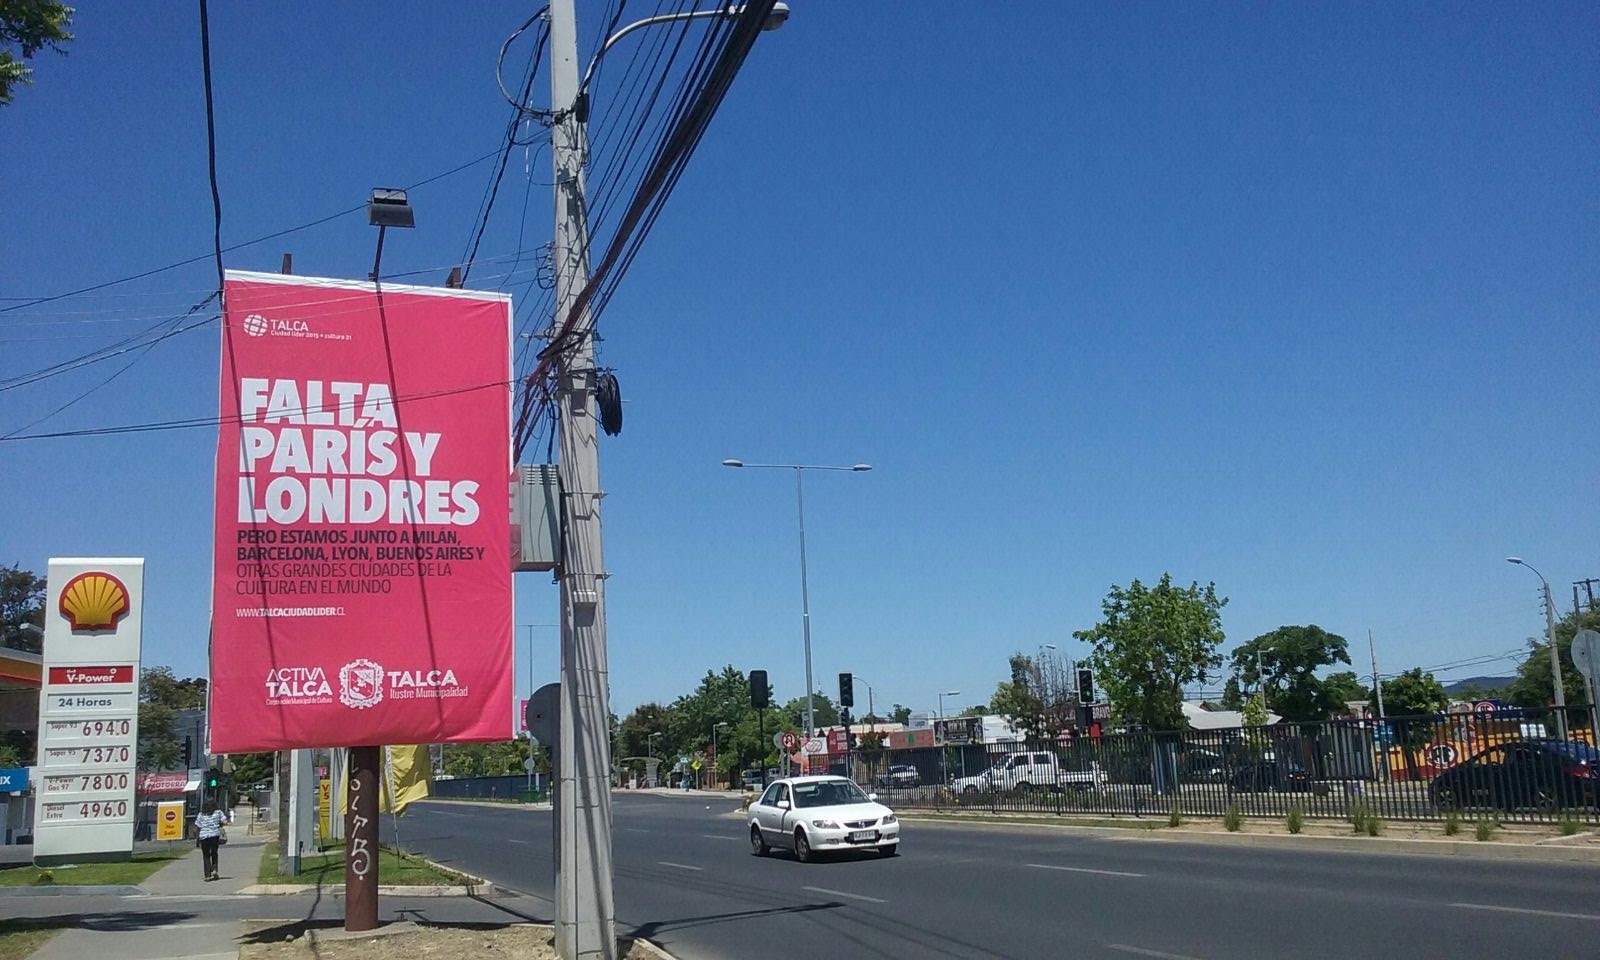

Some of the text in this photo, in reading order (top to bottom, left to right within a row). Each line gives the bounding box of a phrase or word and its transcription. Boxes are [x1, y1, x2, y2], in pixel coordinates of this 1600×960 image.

[271, 320, 309, 331] TALCA
[241, 378, 398, 428] FALTA
[239, 418, 441, 477] PARÍS Y
[238, 476, 480, 526] LONDRES
[237, 527, 461, 546] PERO ESTAMOS JUNTO A MILÁN,
[237, 547, 485, 562] BARCELONA, LYON, BUENOS AIRES Y
[236, 563, 452, 578] OTRAS GRANDES CIUDADES DE LA
[236, 579, 392, 595] CULTURA EN EL MUNDO
[66, 674, 114, 683] V-Power
[266, 667, 326, 682] ACTIVA
[387, 669, 459, 688] TALCA
[265, 681, 333, 697] TALCA
[416, 686, 468, 699] Municipalidad
[58, 698, 112, 707] 24 Horas
[82, 721, 130, 736] 694.0
[81, 747, 129, 763] 737.0
[80, 774, 128, 791] 780.0
[79, 801, 127, 818] 496.0
